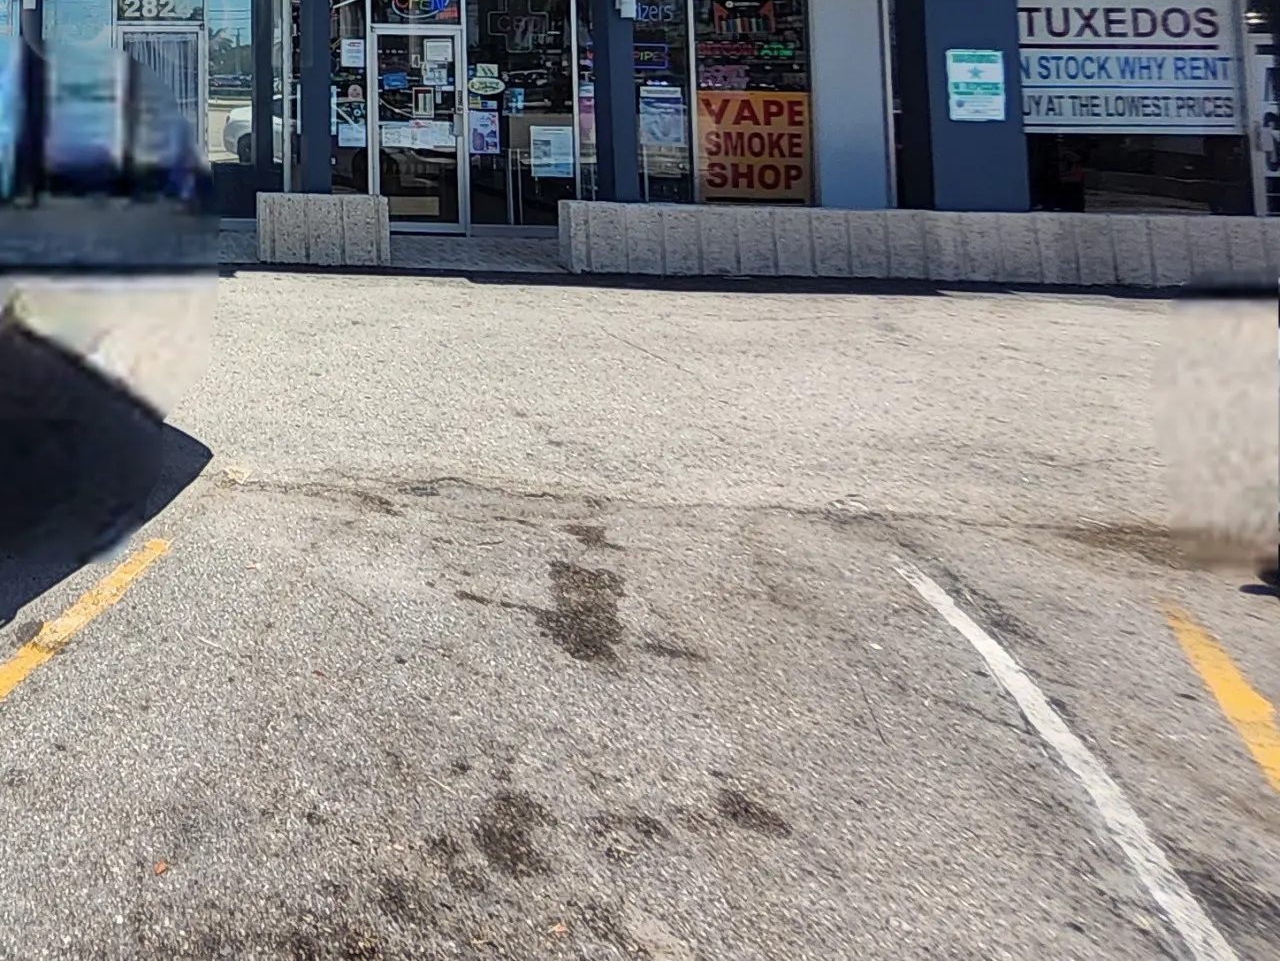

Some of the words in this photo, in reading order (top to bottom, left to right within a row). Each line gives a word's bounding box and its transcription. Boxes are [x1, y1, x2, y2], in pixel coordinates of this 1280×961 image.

[634, 2, 674, 22] izers
[1017, 6, 1220, 38] TUXEDOS
[1037, 55, 1114, 80] STOCK
[1115, 56, 1166, 80] WHY
[1173, 56, 1230, 80] RENT
[701, 99, 804, 126] VAPE
[1044, 94, 1065, 116] AT
[1068, 94, 1102, 117] THE
[1105, 95, 1172, 118] LOWEST
[1175, 96, 1234, 118] PRICES
[704, 132, 803, 159] SMOKE
[706, 163, 803, 190] SHOP
